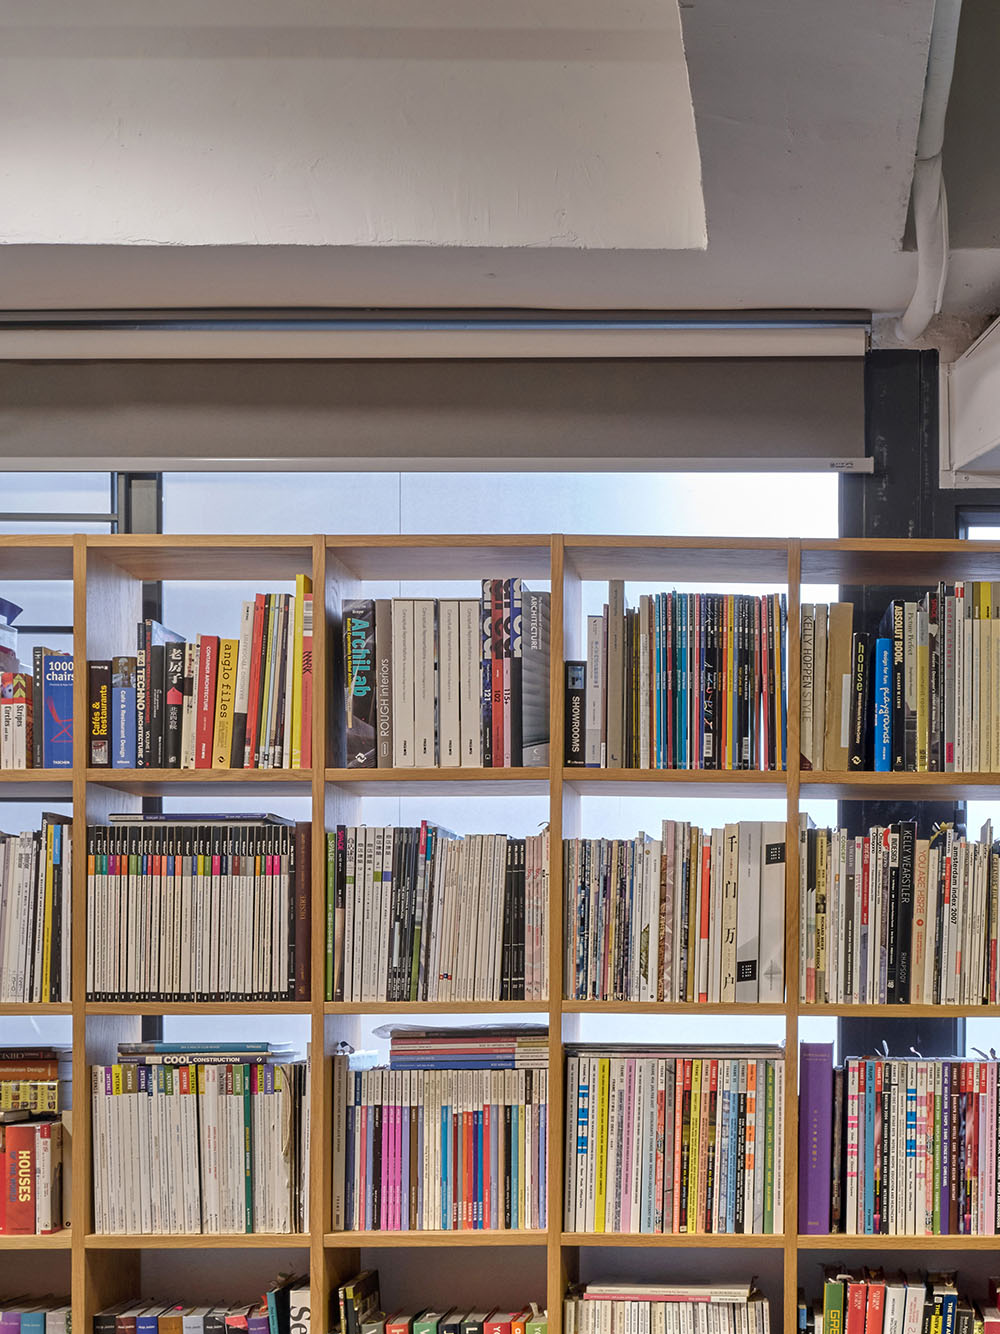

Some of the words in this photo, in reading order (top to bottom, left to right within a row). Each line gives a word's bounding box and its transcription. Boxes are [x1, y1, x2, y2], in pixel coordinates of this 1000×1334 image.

[530, 596, 538, 650] ARCHITECTURE
[803, 614, 813, 646] KELLY
[893, 605, 904, 638] ABSOLUT
[49, 660, 74, 671] 1000
[203, 646, 211, 673] CONTAINER
[221, 643, 232, 681] anglo
[350, 617, 372, 697] ArchiLab
[803, 647, 813, 690] HOPPEN
[856, 641, 866, 692] house
[46, 672, 74, 682] chairs
[137, 668, 146, 711] TECHNO
[202, 673, 210, 712] ARCHITECTURE
[380, 658, 389, 693] interiors
[15, 705, 25, 728] Stripes
[92, 701, 101, 709] &
[99, 684, 108, 736] Restaurants
[219, 683, 231, 719] files
[380, 694, 390, 737] ROUGH
[801, 691, 812, 721] STYLE
[879, 687, 891, 745] playgrounds
[91, 711, 102, 736] Cafés
[571, 695, 580, 753] SHOWROOMS
[890, 837, 898, 863] INDESIGN
[903, 829, 913, 853] KELLY
[918, 849, 927, 869] YOU
[951, 845, 959, 886] amsterdam
[901, 854, 913, 904] WEARSTLER
[917, 870, 926, 888] ARE
[163, 1056, 193, 1065] COOL
[18, 1150, 31, 1202] HOUSES
